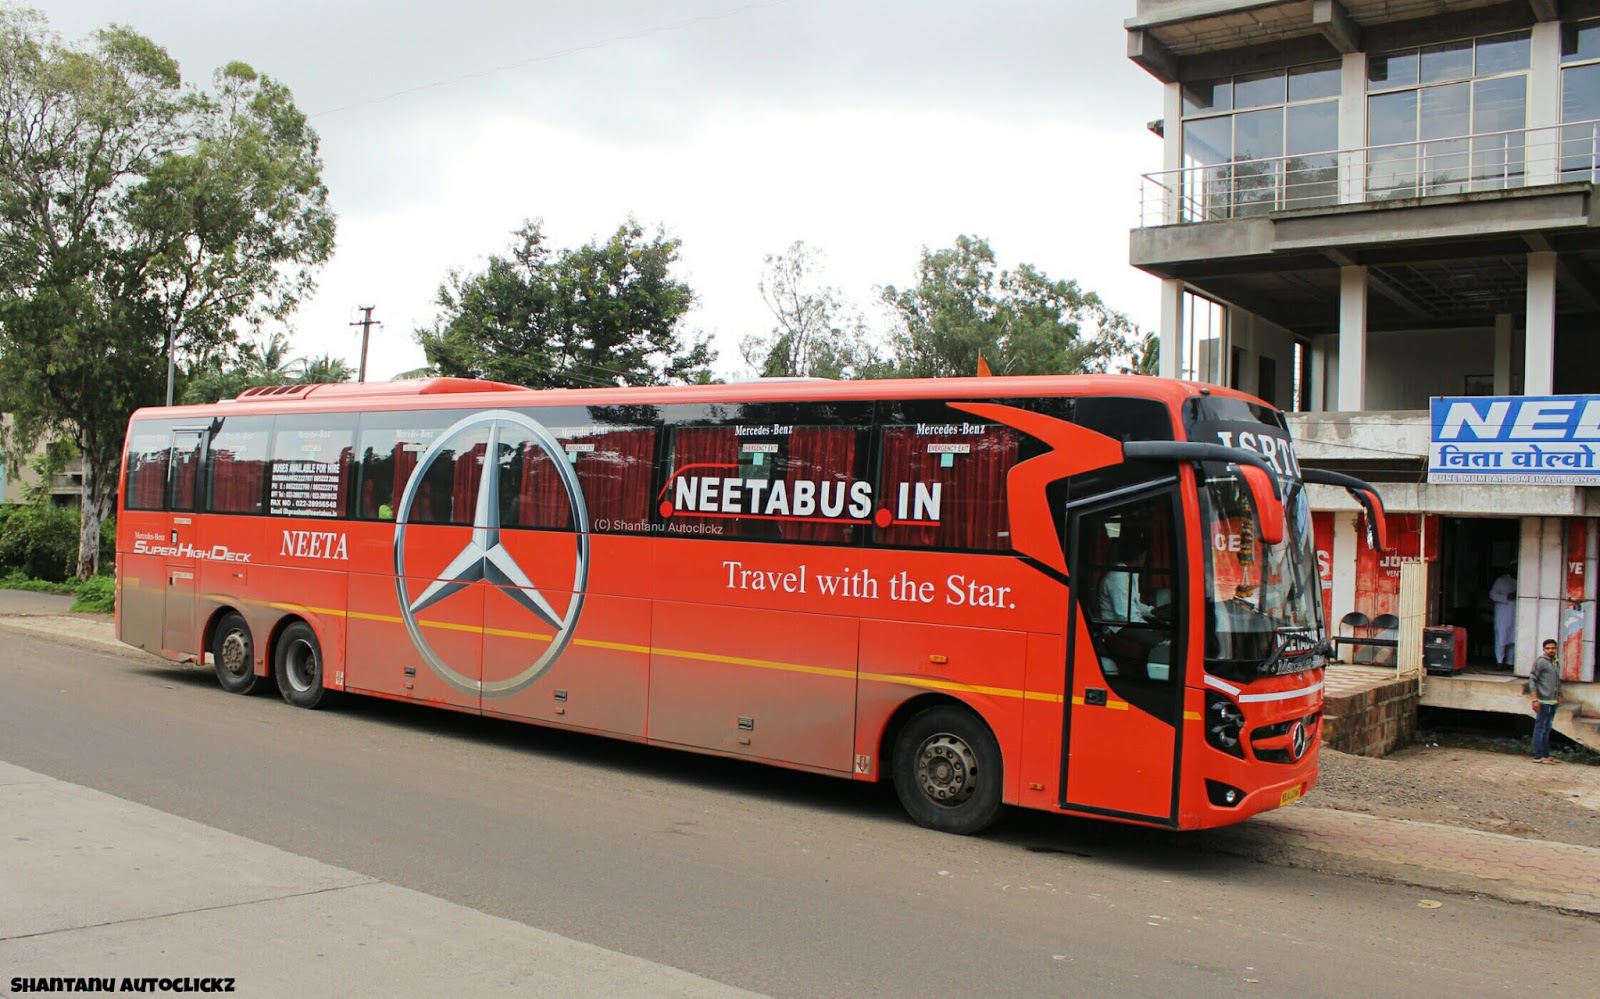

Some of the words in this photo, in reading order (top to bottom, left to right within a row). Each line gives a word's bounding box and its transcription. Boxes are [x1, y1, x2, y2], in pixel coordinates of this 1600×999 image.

[735, 423, 793, 436] Mercedes-Benz
[916, 422, 986, 436] Mercedes-Benz
[1439, 444, 1503, 467] निता
[1511, 444, 1596, 468] वोल्वो
[273, 463, 289, 473] BUSES
[289, 463, 316, 473] AVAILABLE
[316, 463, 327, 473] FOR
[327, 463, 340, 474] HIRE
[280, 530, 349, 560] NEETA
[723, 561, 807, 594] Travel
[816, 567, 879, 599] with
[889, 571, 935, 603] the
[946, 574, 1016, 610] Star.
